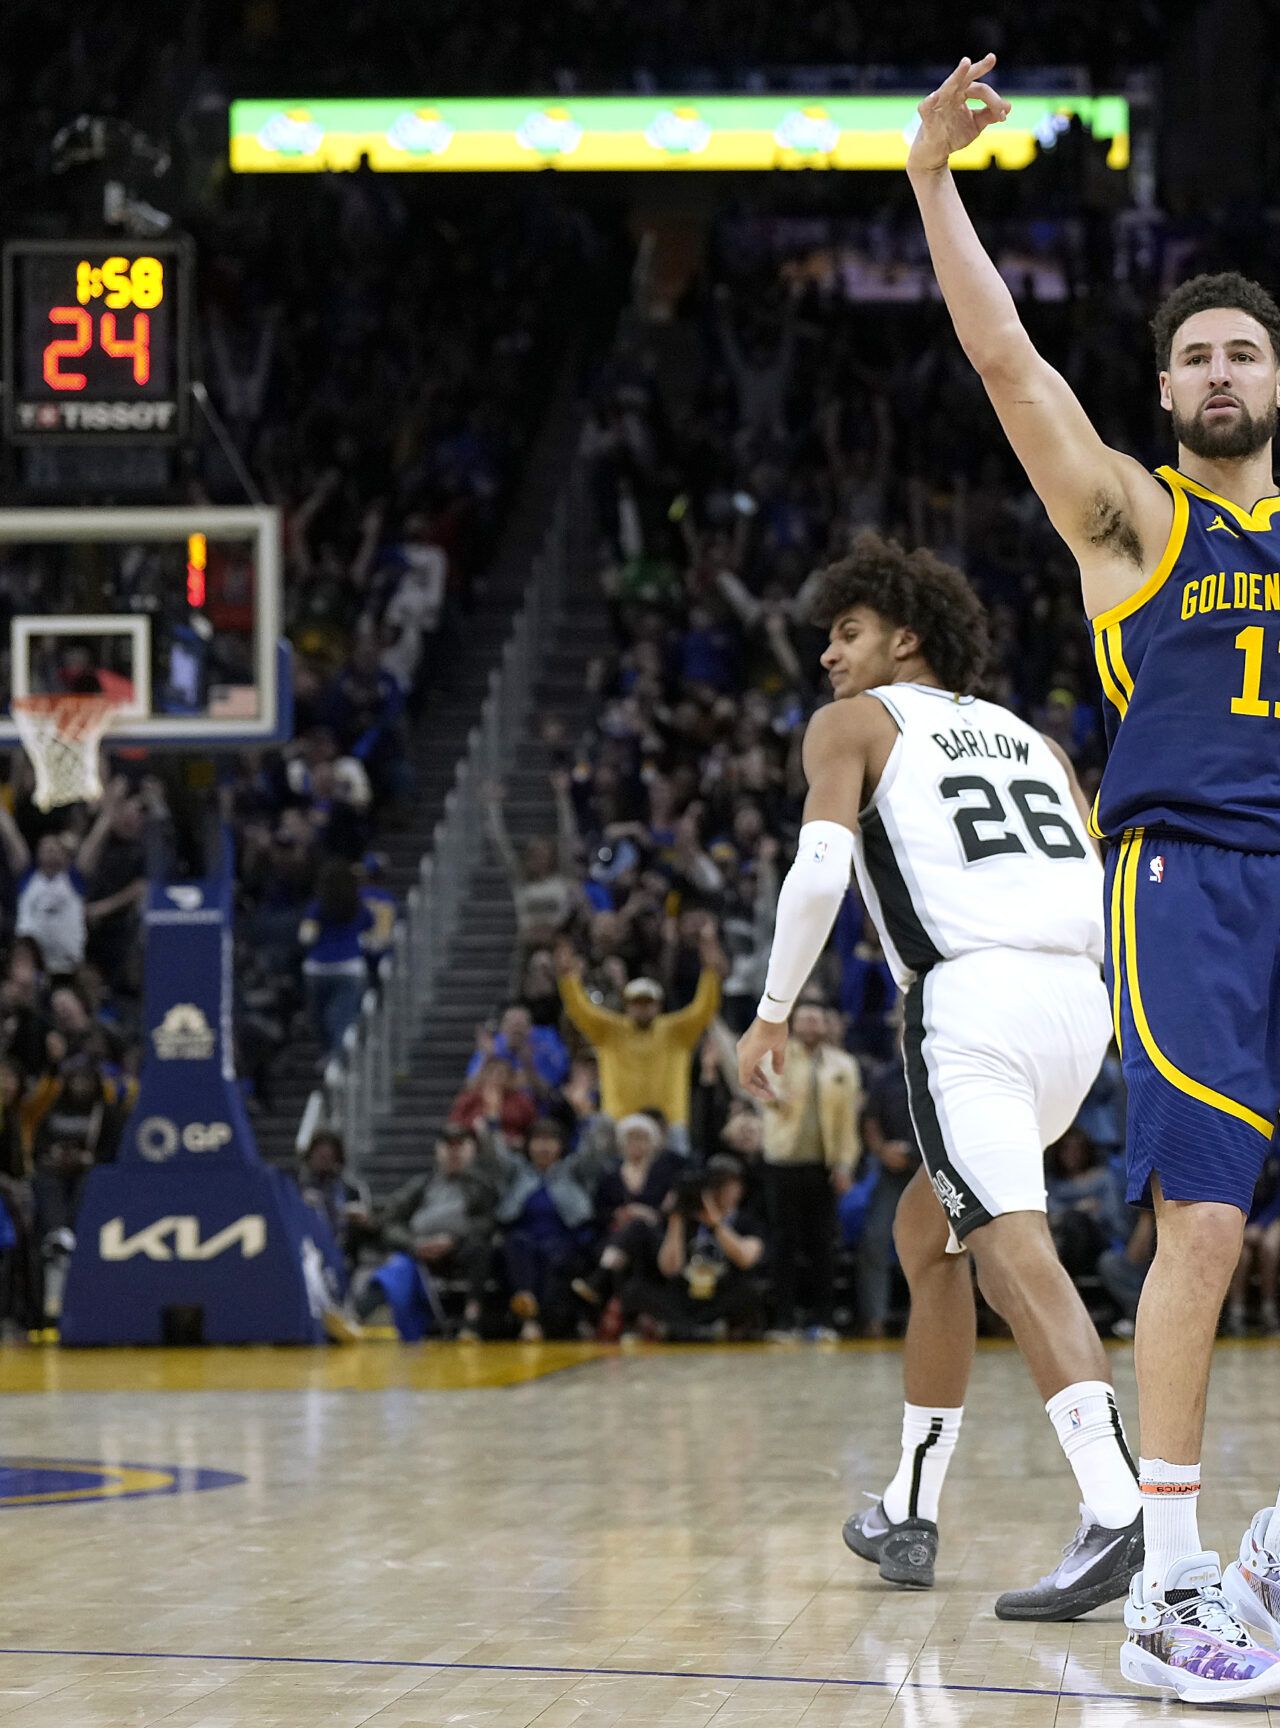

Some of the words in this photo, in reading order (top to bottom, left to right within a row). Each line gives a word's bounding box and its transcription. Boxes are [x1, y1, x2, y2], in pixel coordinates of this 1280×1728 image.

[76, 256, 163, 309] 1:58
[43, 306, 150, 391] 24
[62, 401, 177, 430] TISSOT
[1181, 572, 1280, 621] GOLDEN
[931, 728, 1029, 765] BARLOW
[938, 774, 1087, 866] 26
